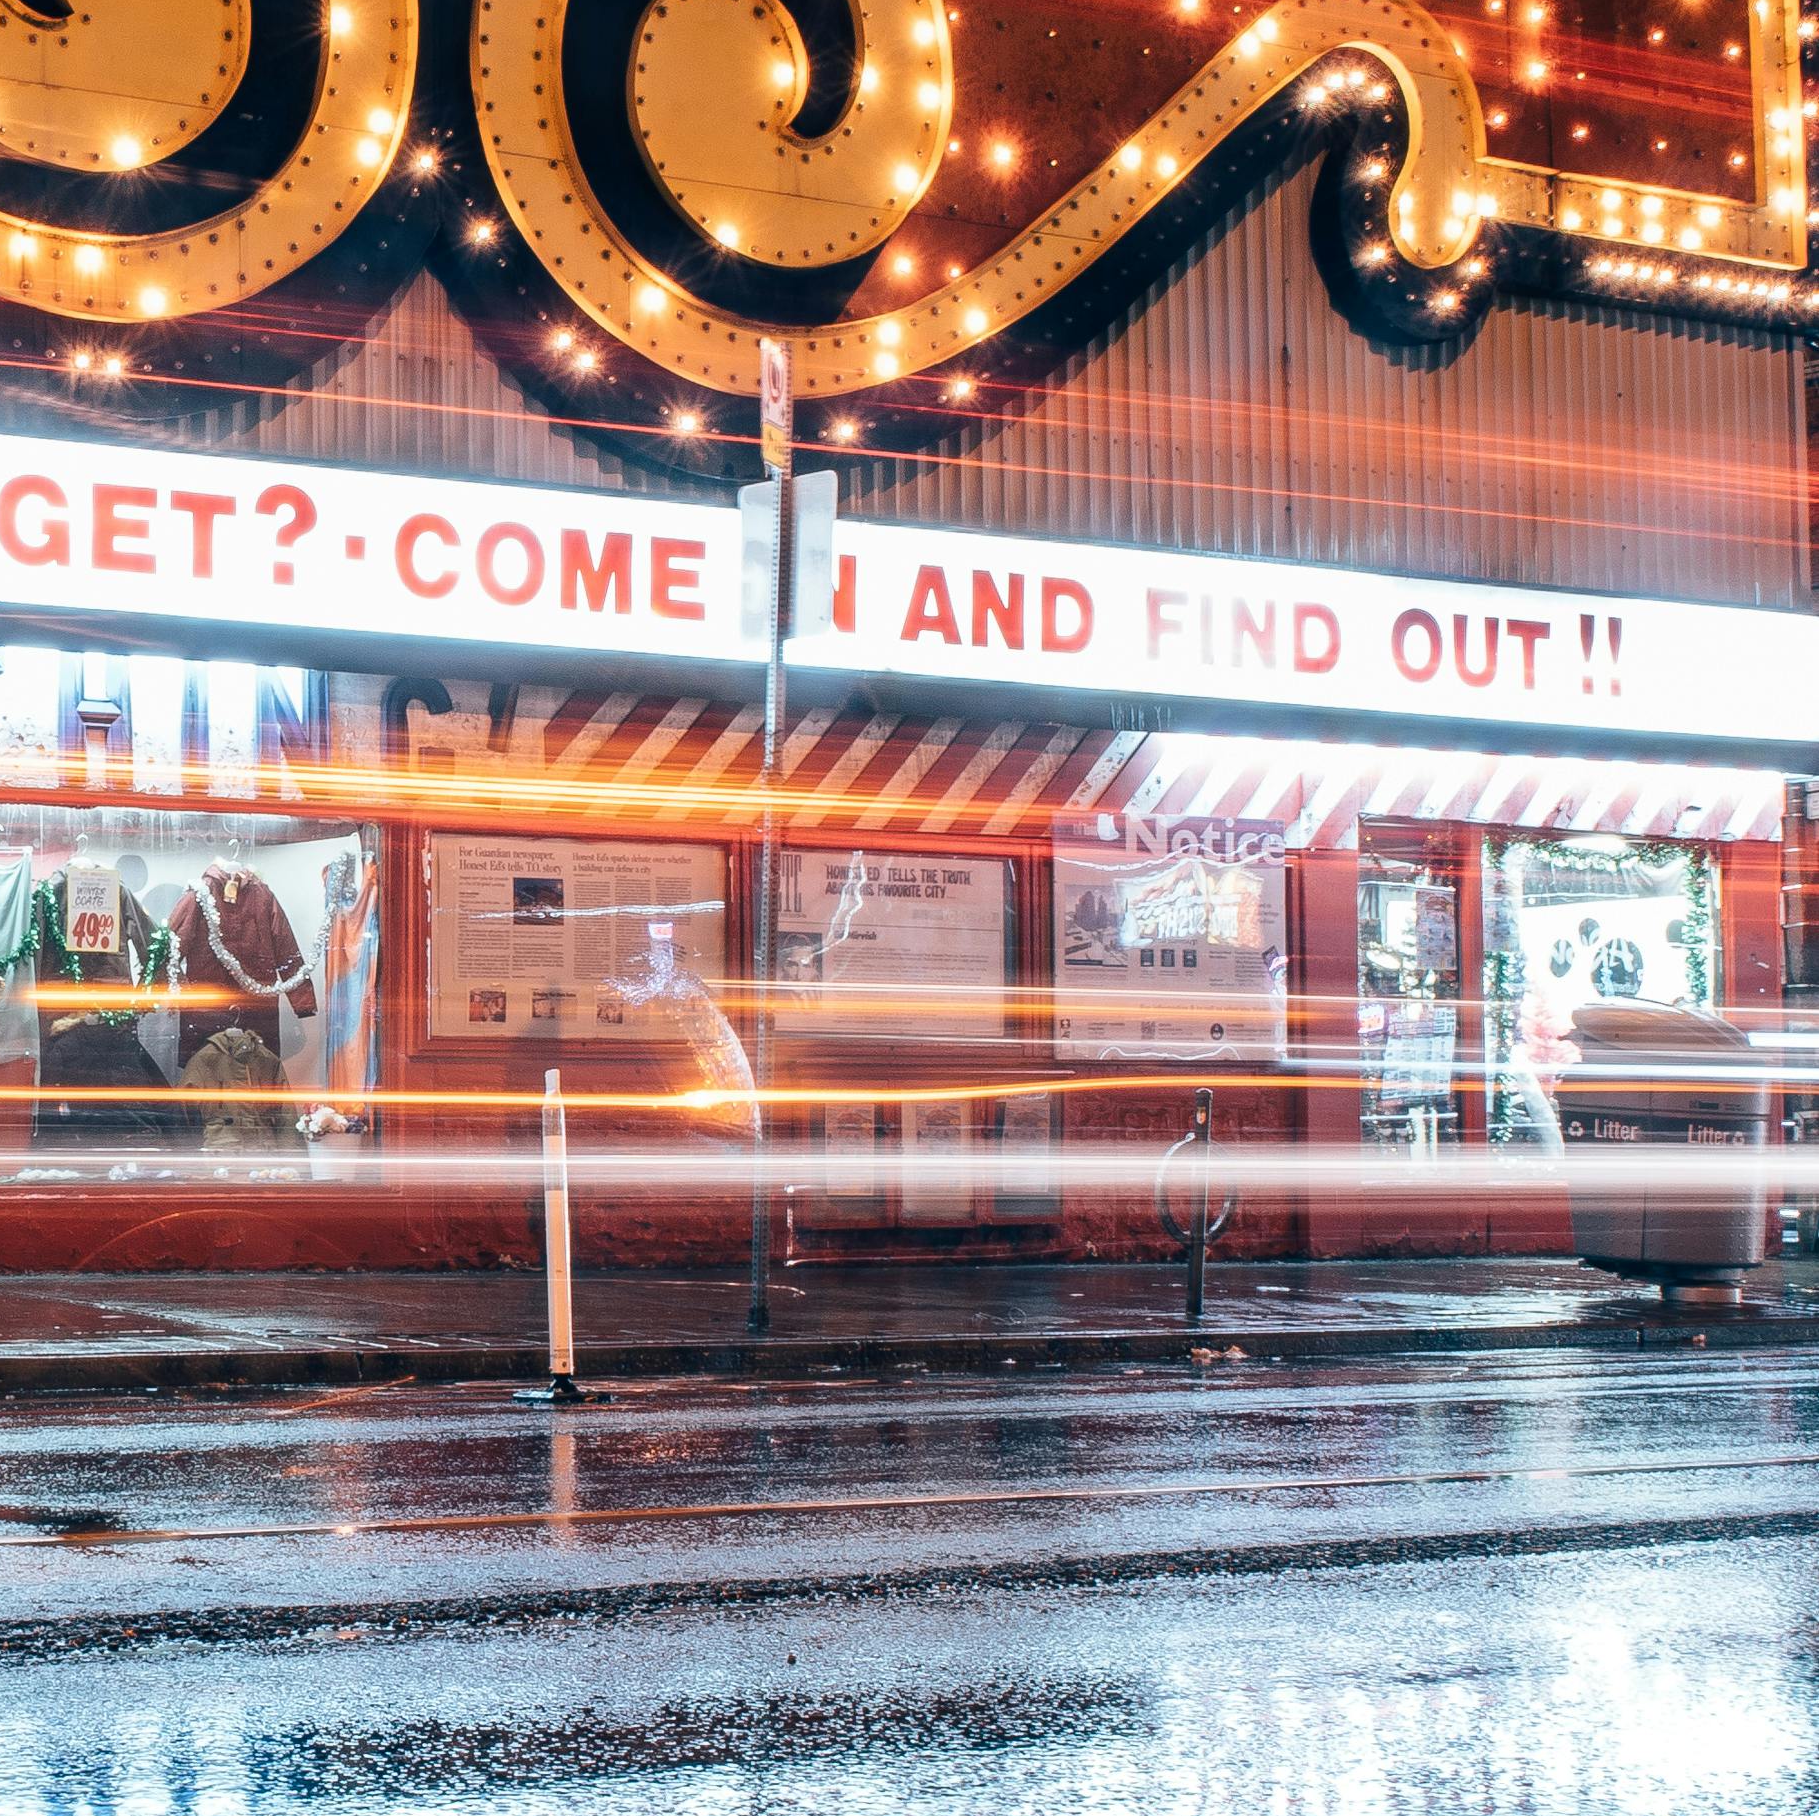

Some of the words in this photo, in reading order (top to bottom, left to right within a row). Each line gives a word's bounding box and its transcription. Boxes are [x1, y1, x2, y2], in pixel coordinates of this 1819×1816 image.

[393, 512, 706, 620] COME
[899, 565, 1094, 654] AND
[1146, 587, 1342, 674] FIND
[1125, 814, 1286, 867] Notice
[459, 847, 473, 857] For
[475, 847, 511, 858] Guardian
[459, 860, 487, 871] Honest
[887, 868, 917, 883] TELLS
[921, 869, 938, 884] THE
[941, 870, 972, 885] TRUTH
[825, 881, 854, 895] ABOT
[1594, 1118, 1638, 1141] Litter
[1688, 1124, 1730, 1144] Litter
